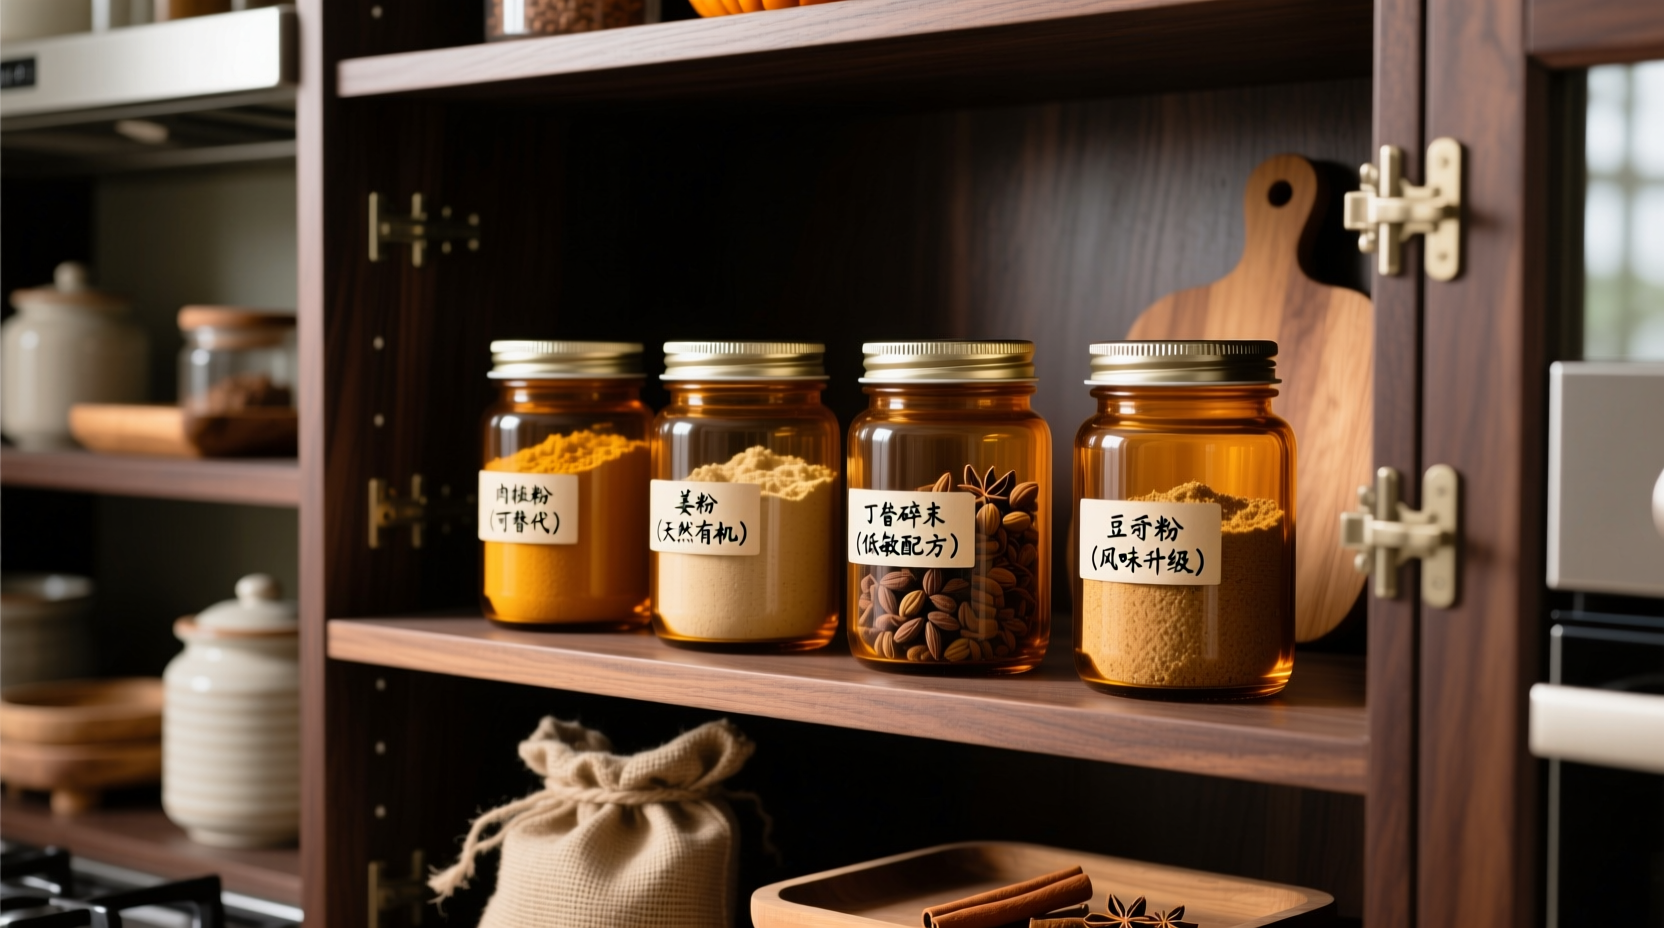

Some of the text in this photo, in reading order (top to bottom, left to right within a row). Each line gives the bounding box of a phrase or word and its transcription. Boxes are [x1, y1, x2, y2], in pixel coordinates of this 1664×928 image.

[674, 488, 718, 517] 姜粉
[490, 509, 560, 535] (可替代)
[656, 518, 747, 547] (天然有机)
[856, 531, 959, 559] (低敏配方)
[1091, 545, 1205, 577] (风味升级)
